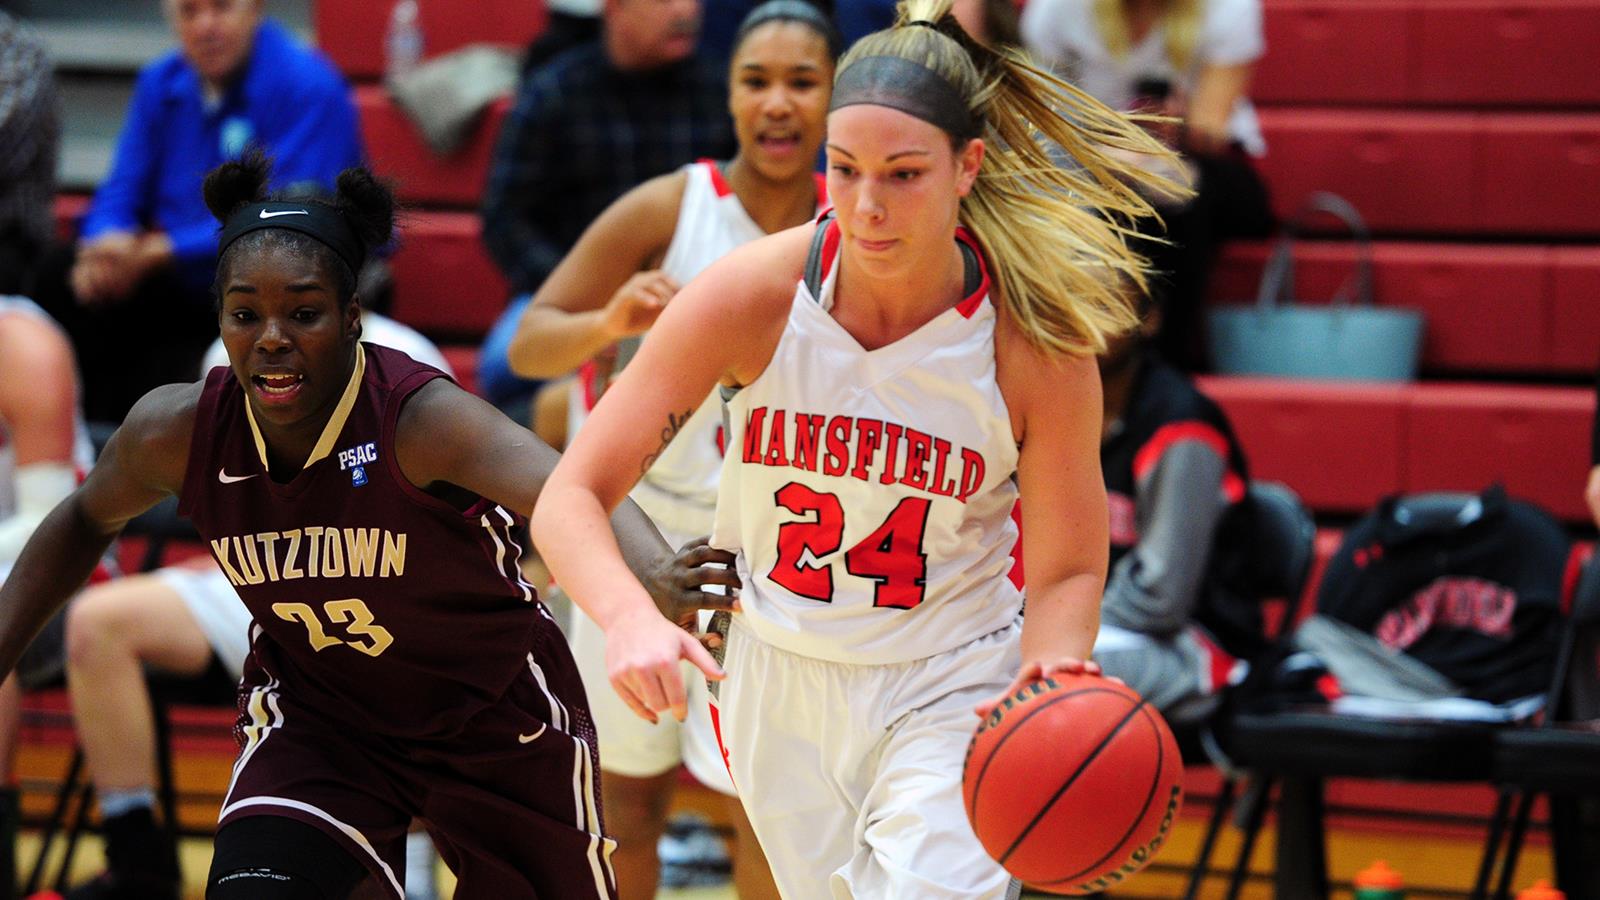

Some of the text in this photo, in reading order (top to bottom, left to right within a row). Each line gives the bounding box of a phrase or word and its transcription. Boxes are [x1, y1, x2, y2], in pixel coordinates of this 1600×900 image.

[338, 443, 377, 470] PSAC
[742, 406, 986, 504] MANSFIELD
[211, 526, 407, 586] KUTZTOWN
[767, 481, 933, 610] 24
[271, 598, 395, 657] 23
